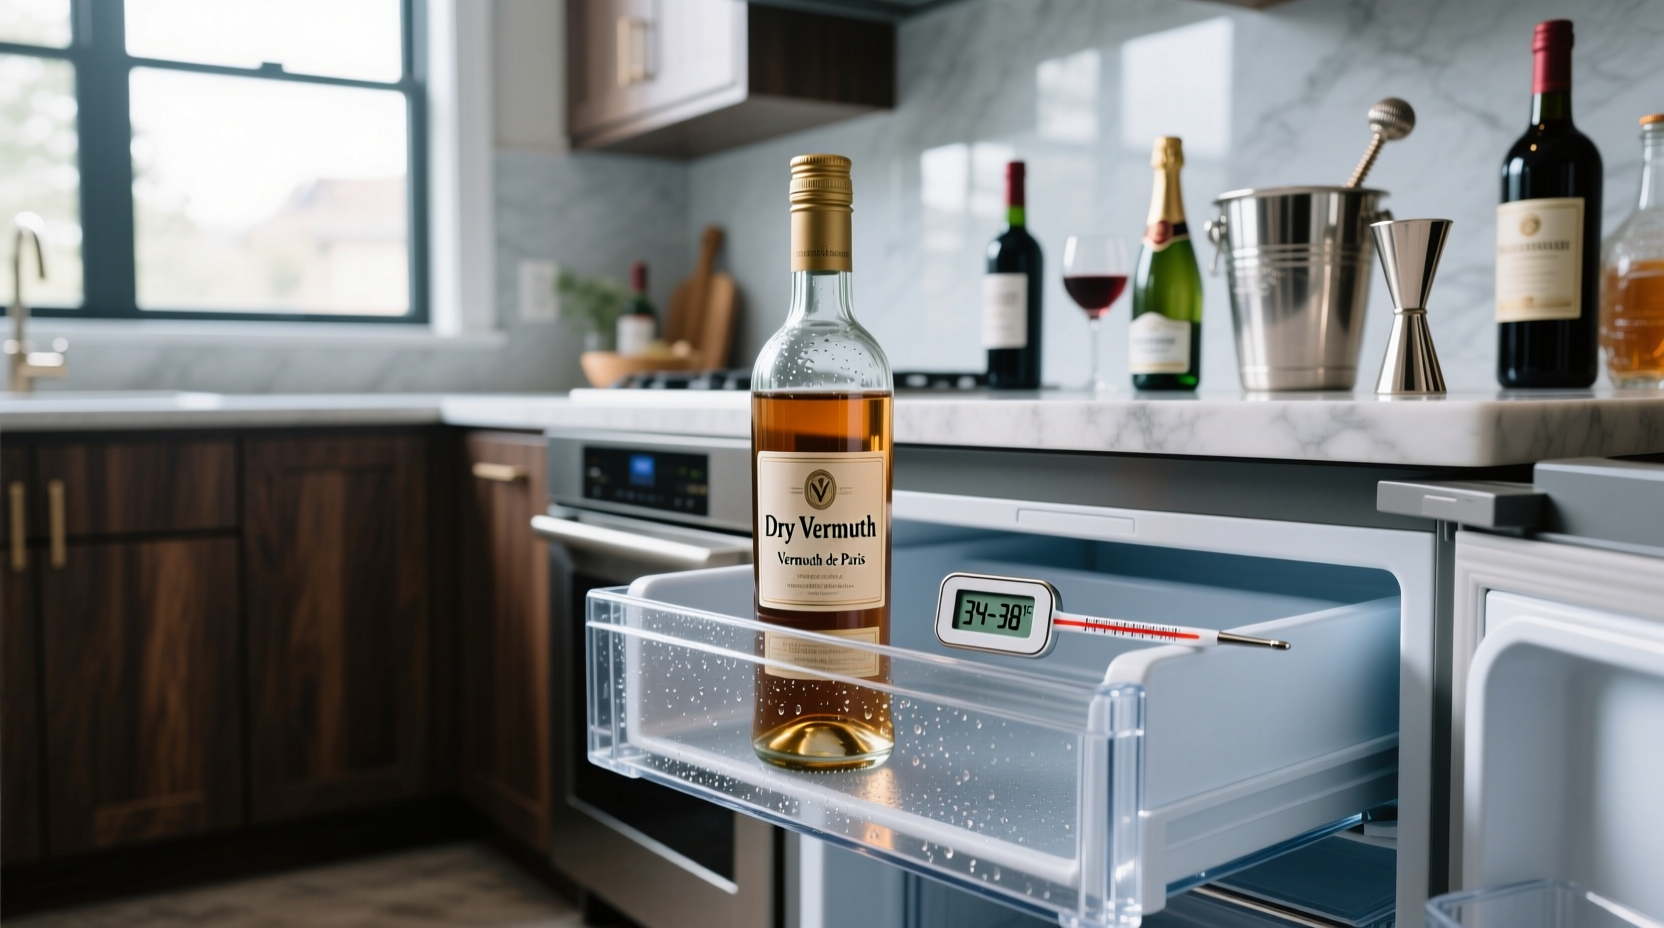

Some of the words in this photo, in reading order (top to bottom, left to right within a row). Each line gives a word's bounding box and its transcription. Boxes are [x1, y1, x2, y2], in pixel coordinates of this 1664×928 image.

[765, 514, 795, 544] Dry
[799, 514, 876, 539] Vermuth
[826, 553, 838, 566] de
[841, 553, 865, 566] Paris
